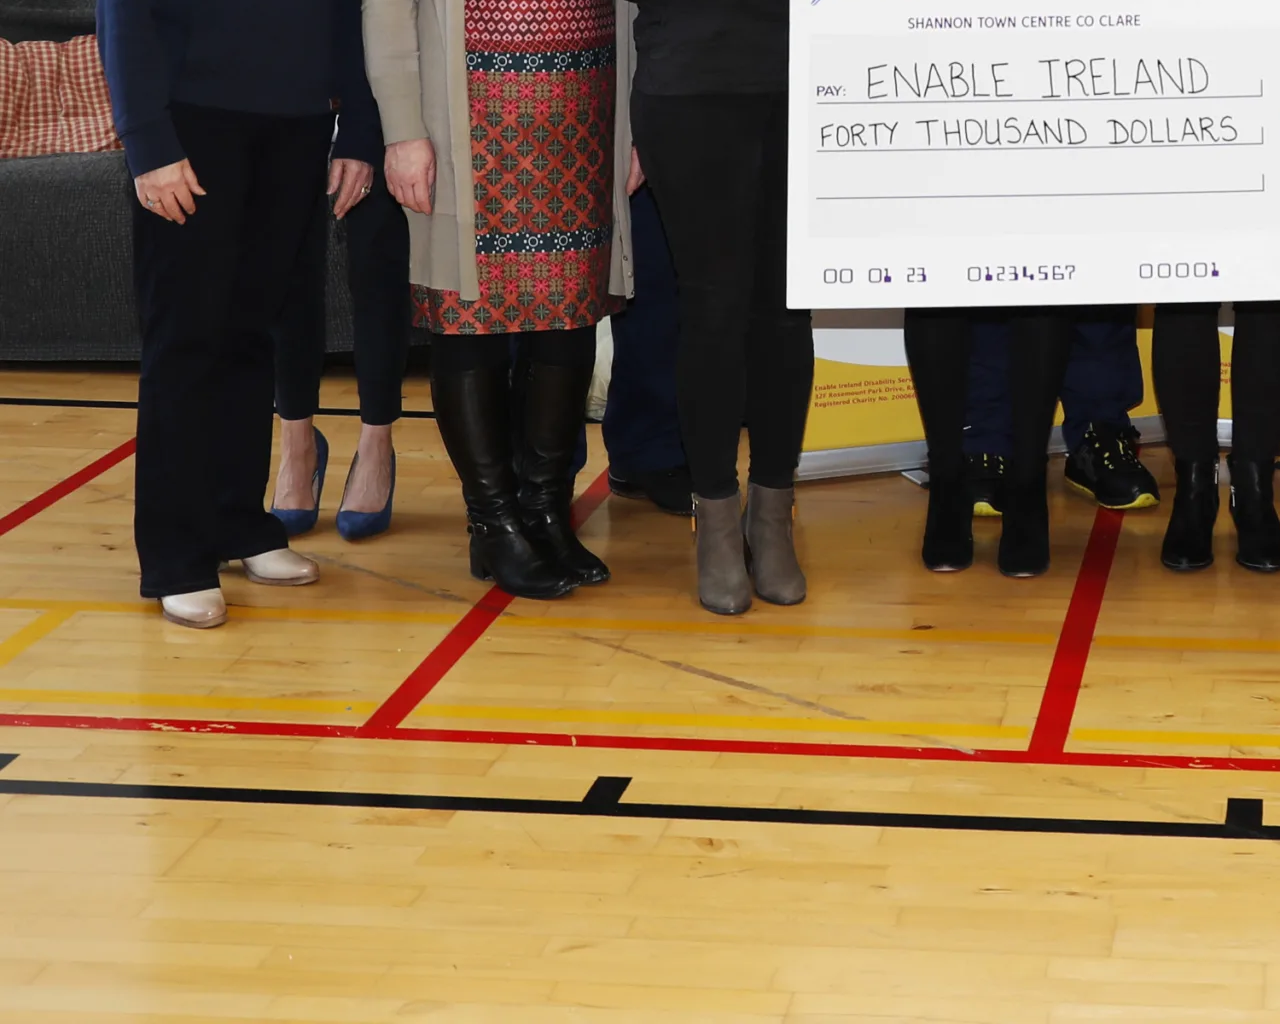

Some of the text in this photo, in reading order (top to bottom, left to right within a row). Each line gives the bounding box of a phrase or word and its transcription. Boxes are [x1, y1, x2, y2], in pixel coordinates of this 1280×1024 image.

[908, 14, 1141, 29] SHANNON TOWN CENTRE CO CLARE
[816, 57, 1209, 99] PAY: ENABLE IRELAND
[820, 115, 1238, 148] FORTY THOUSAND DOLLARS
[967, 264, 1076, 282] 01234567
[1139, 262, 1220, 280] 00001
[839, 381, 862, 389] Ireland
[863, 378, 896, 387] Disability
[828, 389, 867, 398] Rosemount
[867, 387, 882, 395] Park
[814, 398, 850, 408] Registered
[852, 395, 876, 405] Charity
